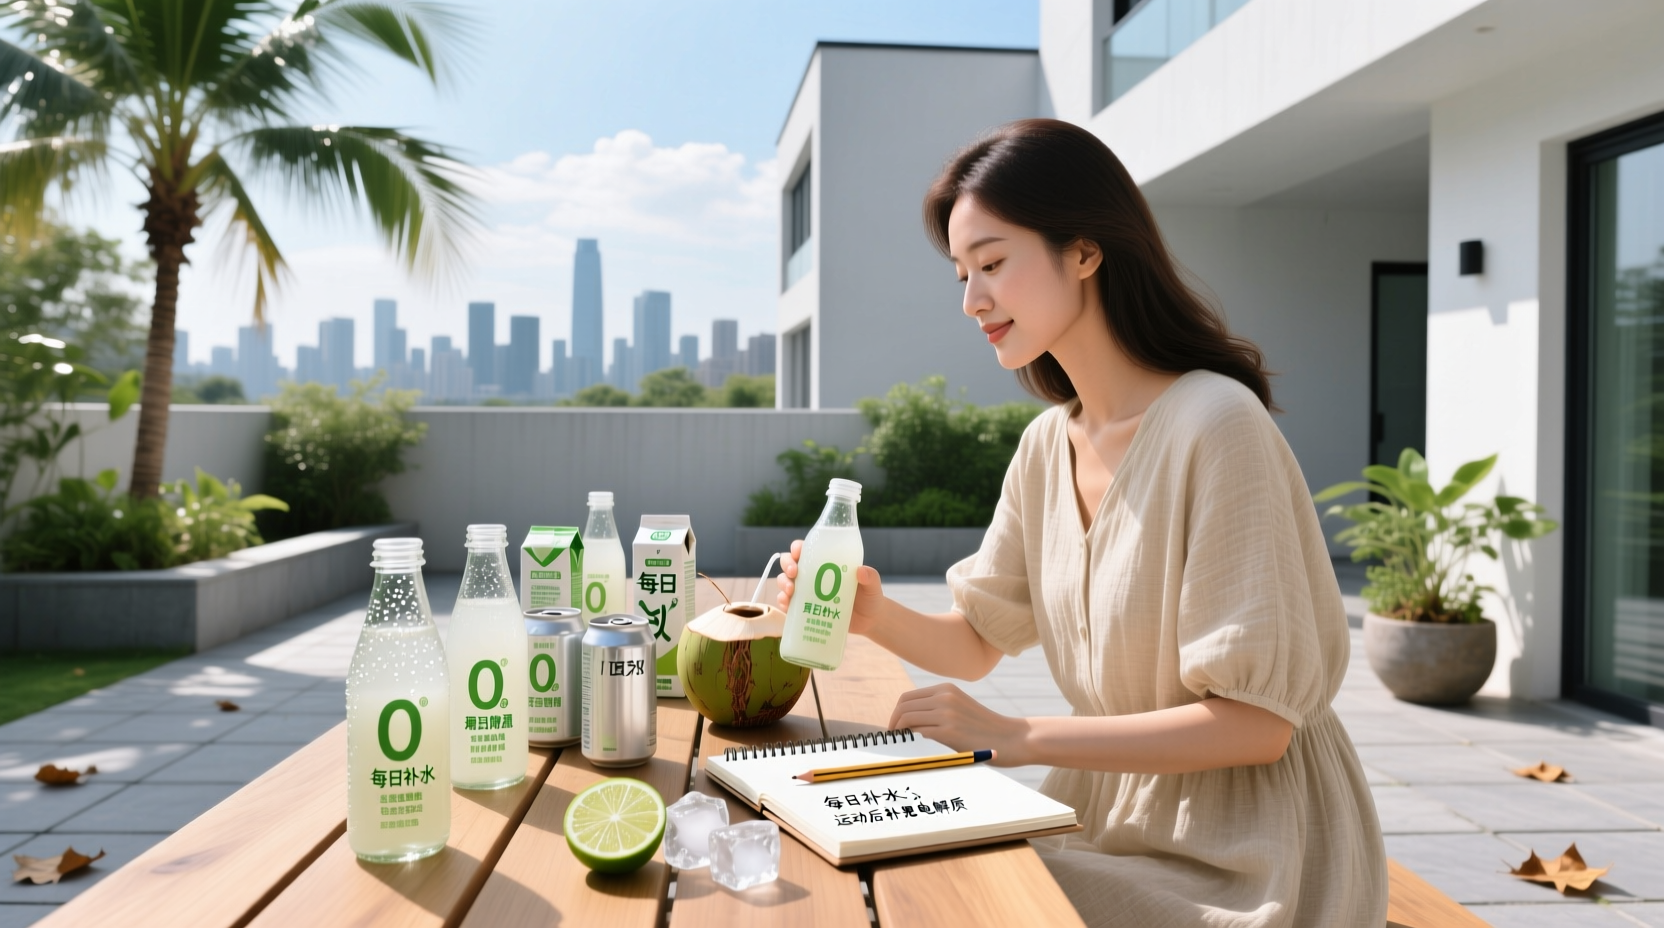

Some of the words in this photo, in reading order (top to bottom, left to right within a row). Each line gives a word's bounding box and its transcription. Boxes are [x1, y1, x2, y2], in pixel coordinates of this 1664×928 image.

[637, 571, 677, 595] 每日
[814, 562, 842, 602] 0
[468, 659, 503, 710] 0
[378, 699, 422, 761] 0
[370, 764, 435, 788] 每日补水
